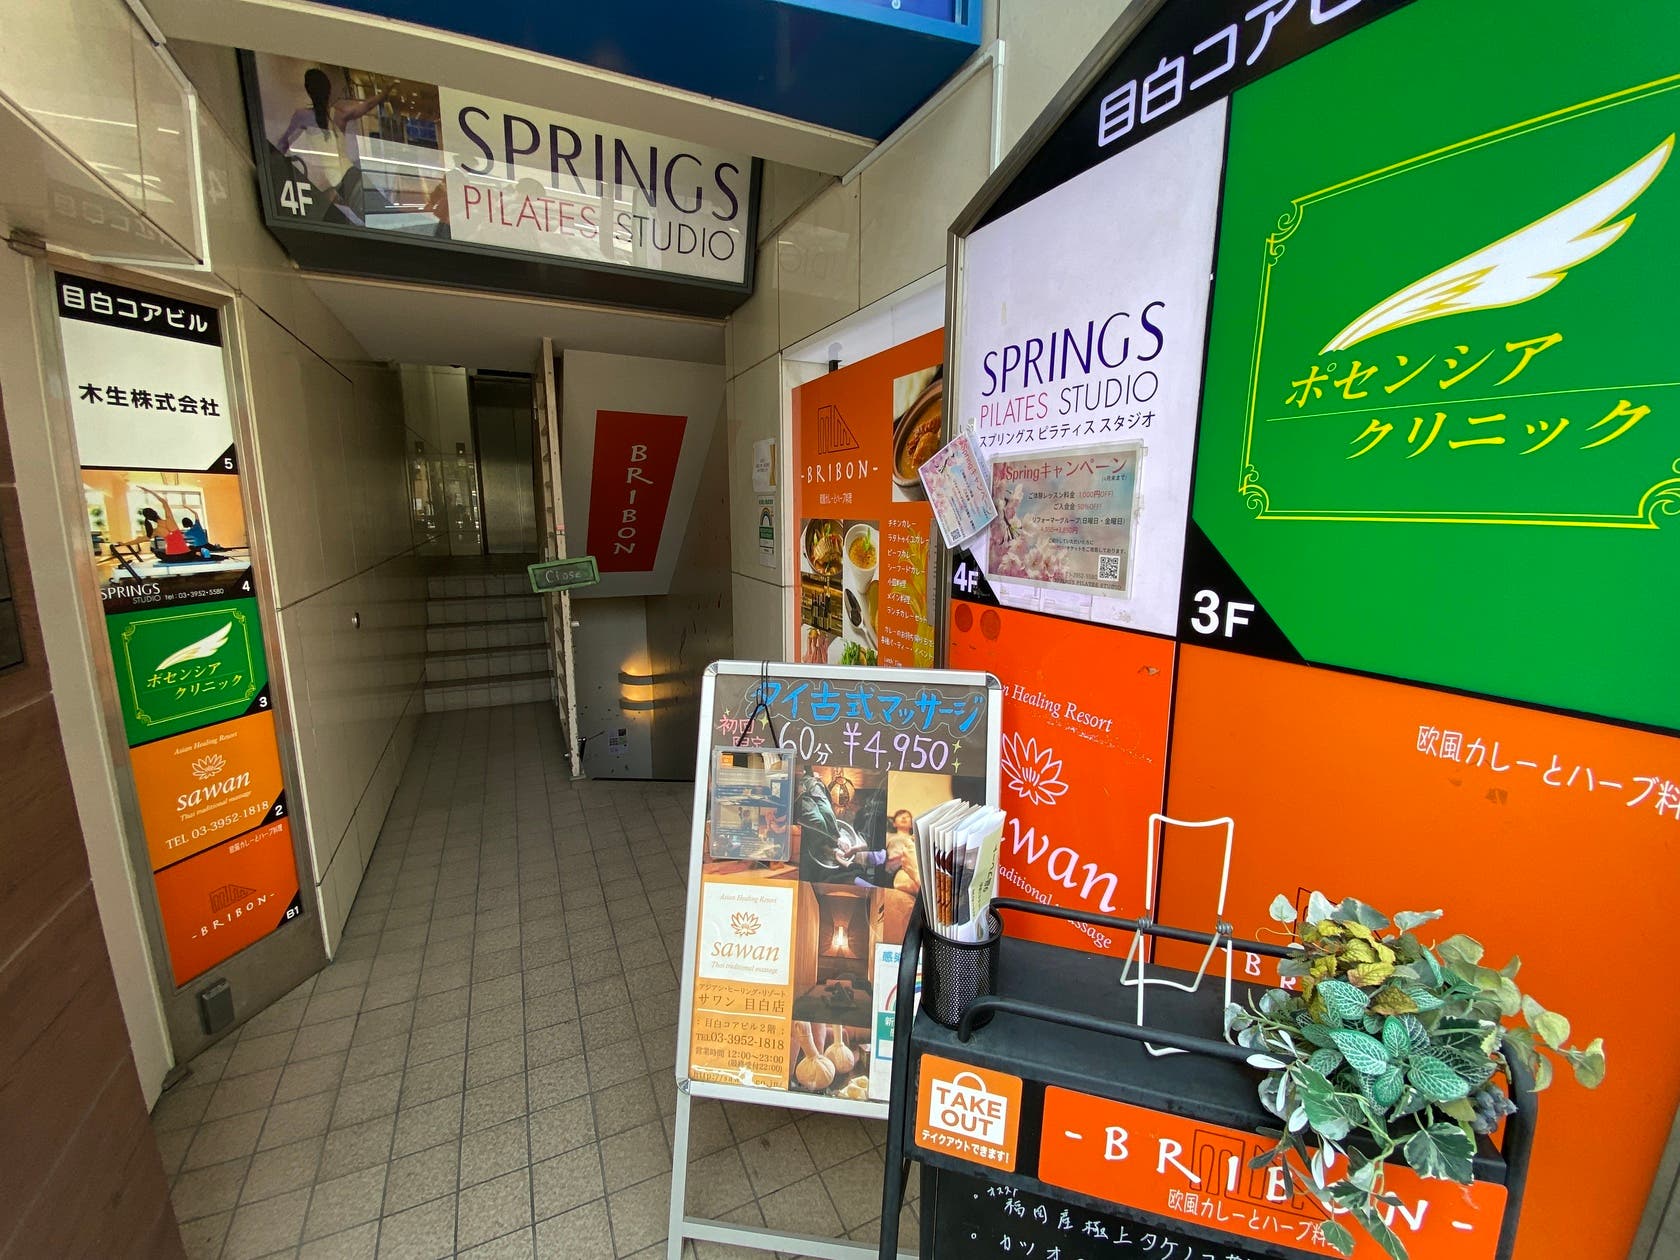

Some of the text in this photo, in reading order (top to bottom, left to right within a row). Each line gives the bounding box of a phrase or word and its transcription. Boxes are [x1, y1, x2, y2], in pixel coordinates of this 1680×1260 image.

[458, 105, 740, 222] SPRINGS
[280, 178, 313, 217] 4F
[463, 184, 735, 261] PILATES STUDIO
[62, 284, 209, 333] 目白コアビル
[981, 300, 1166, 397] SPRINGS
[1285, 332, 1563, 408] ポセンシア
[78, 383, 221, 418] 木生株式会社
[980, 371, 1158, 429] PILATES STUDIO
[979, 411, 1156, 448] スプリングス ピラティス スタジオ
[1346, 399, 1652, 460] クリニック
[224, 458, 233, 470] 5
[1005, 458, 1128, 482] Springキャンペーン
[613, 444, 654, 555] BRIBON
[100, 582, 161, 601] SPRINGS
[242, 580, 251, 592] 4
[545, 569, 582, 583] Close
[953, 561, 979, 593] 4F
[132, 594, 161, 605] STUDIO
[1191, 589, 1255, 638] 3F
[147, 662, 222, 688] ポセンシア
[176, 674, 243, 700] クリニック
[258, 696, 268, 708] 3
[748, 680, 985, 732] タイ古式マッサージ
[1011, 684, 1113, 733] Healing Resort
[716, 714, 755, 736] 初回
[779, 721, 949, 772] 60分 ¥4,950
[177, 771, 251, 812] sawan
[164, 800, 270, 850] TEL 03-3952-1818
[274, 804, 284, 816] 2
[1000, 818, 1119, 913] wan
[999, 864, 1053, 905] aditional
[286, 905, 300, 920] B1
[710, 941, 780, 962] sawan
[698, 993, 785, 1013] サワン 目白店
[936, 1086, 1002, 1120] TAKE
[941, 1109, 994, 1137] OUT
[921, 1129, 1010, 1164] テイクアウトできます!
[1168, 1188, 1330, 1248] 欧風カレーとハーブ料
